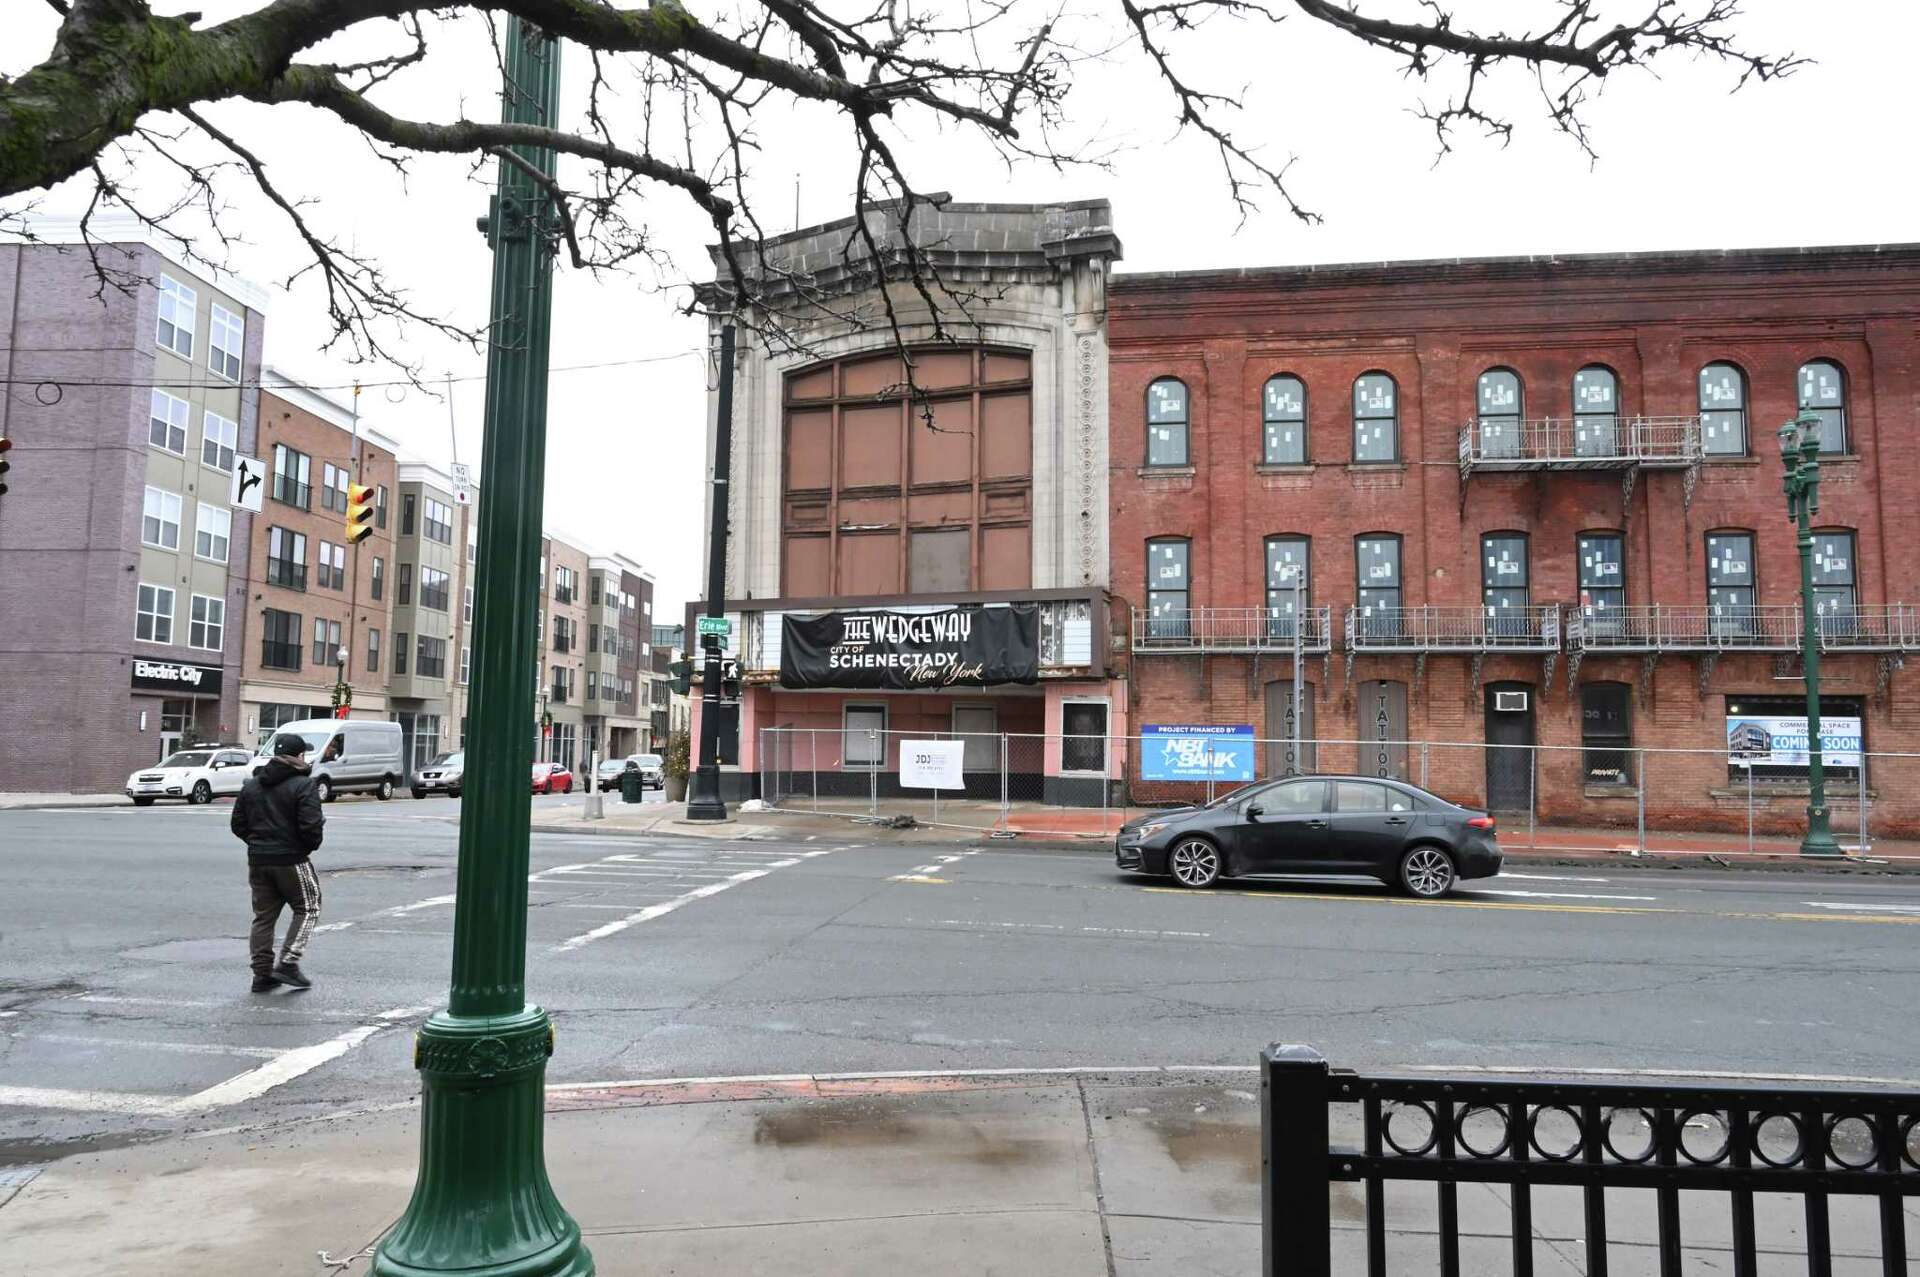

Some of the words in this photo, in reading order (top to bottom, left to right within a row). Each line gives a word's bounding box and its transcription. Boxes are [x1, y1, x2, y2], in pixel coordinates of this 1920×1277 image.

[699, 620, 715, 630] Erie
[843, 620, 870, 641] THE
[871, 613, 971, 644] WEDGEWAY
[830, 646, 850, 654] CITY
[829, 652, 959, 668] SCHENECTADY
[135, 662, 180, 680] Electric
[180, 666, 203, 685] City
[903, 662, 939, 682] New
[942, 661, 983, 686] York
[1376, 695, 1388, 778] TATTOO
[1772, 736, 1809, 749] COMIN
[1823, 737, 1860, 750] SOON
[1166, 739, 1208, 753] NBT
[1177, 752, 1238, 768] BANK
